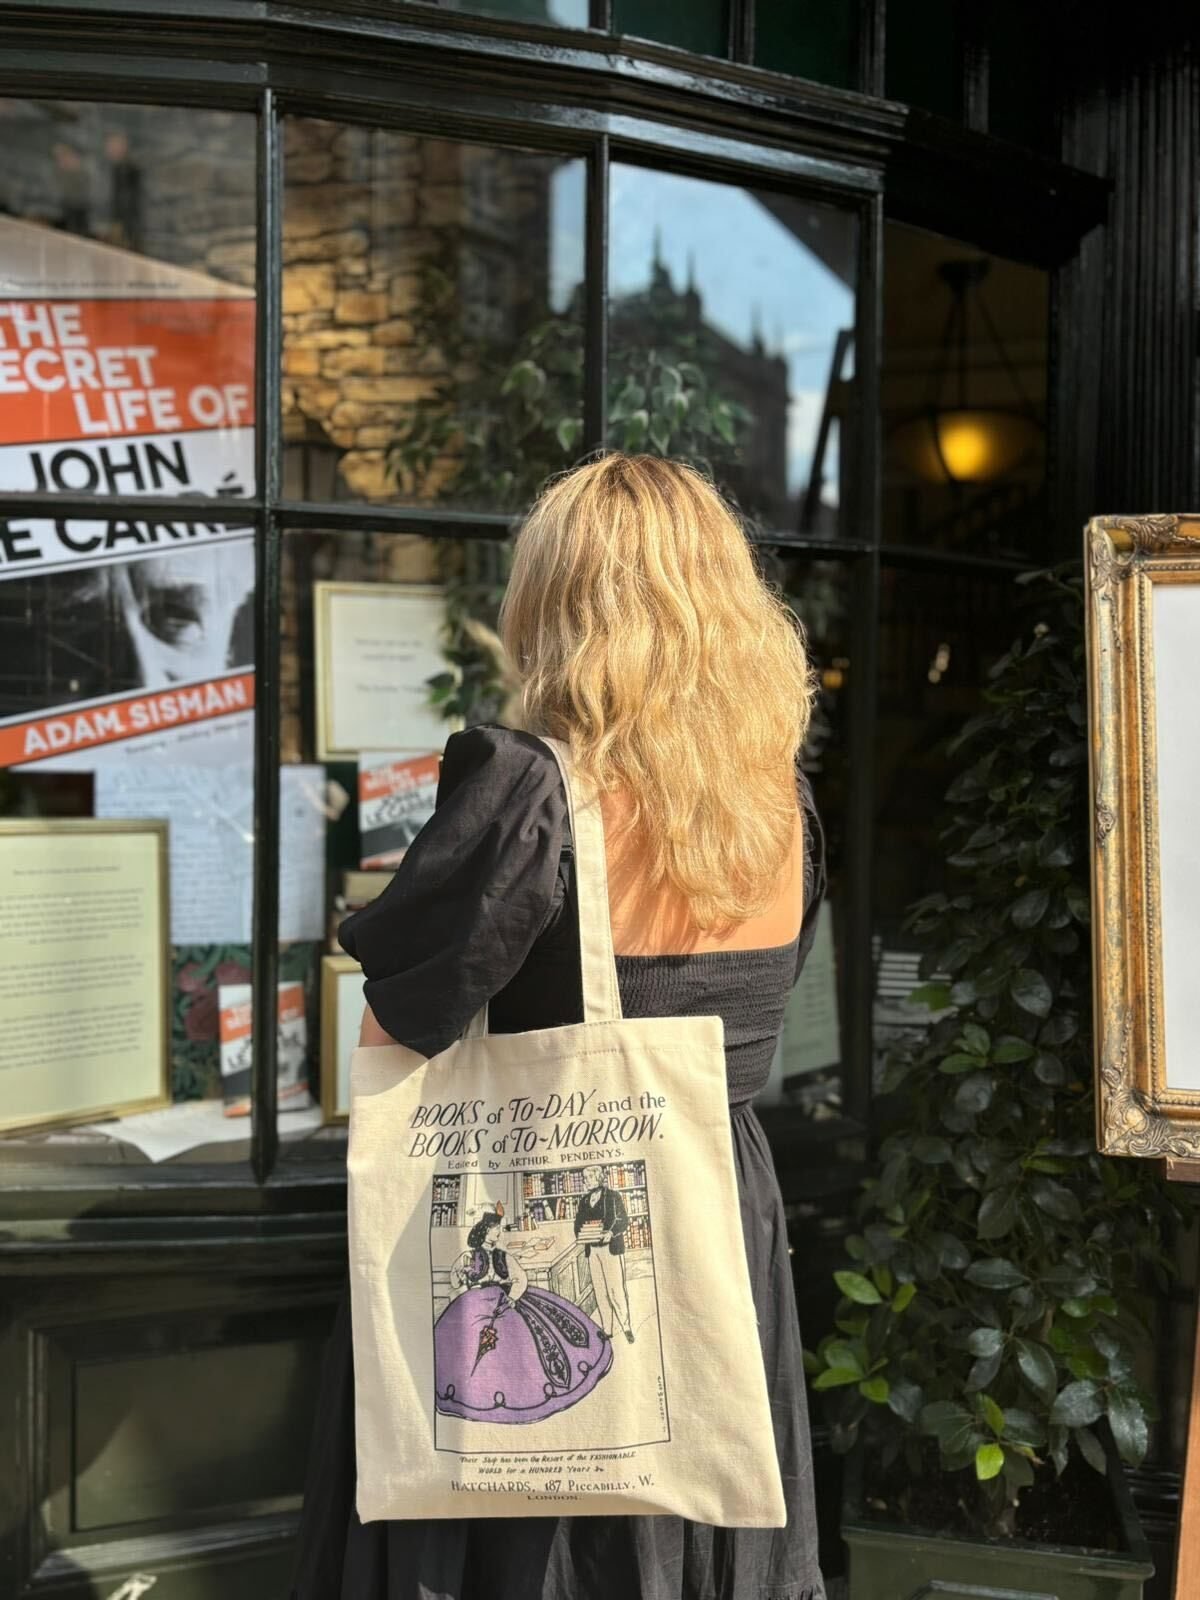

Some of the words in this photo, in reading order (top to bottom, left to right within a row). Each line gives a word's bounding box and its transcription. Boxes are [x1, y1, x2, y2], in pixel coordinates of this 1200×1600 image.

[73, 388, 182, 433] LIFE
[188, 384, 248, 426] OF
[29, 441, 190, 494] JOHN
[24, 706, 127, 756] ADAM
[128, 680, 247, 729] SISMAN
[410, 1100, 484, 1129] BOOKS
[487, 1108, 504, 1124] of
[597, 1096, 632, 1114] and
[639, 1091, 666, 1109] the
[408, 1128, 488, 1158] BOOKS
[492, 1137, 509, 1153] of
[447, 1159, 479, 1169] Edited
[488, 1159, 501, 1171] by
[508, 1155, 550, 1167] ARTHUR
[545, 1480, 562, 1493] 187
[638, 1474, 655, 1487] W.
